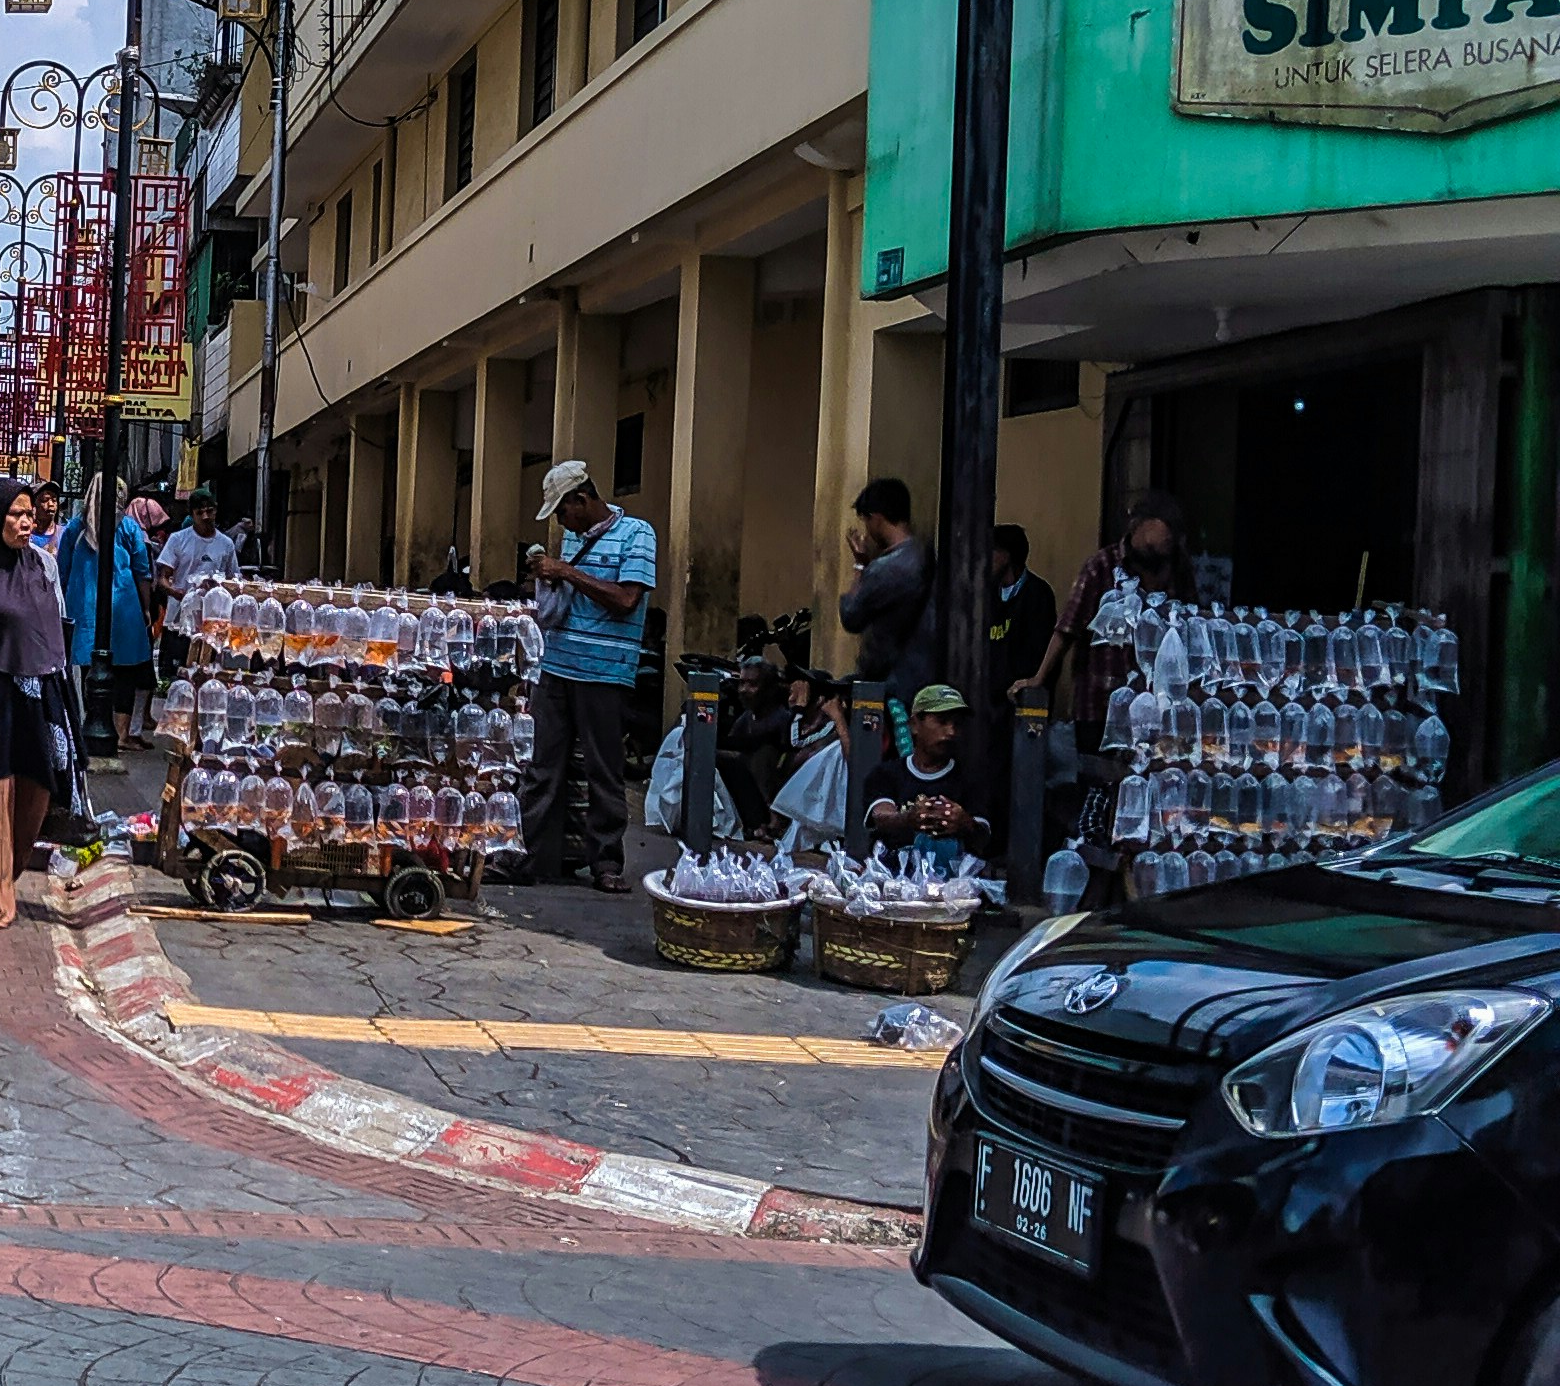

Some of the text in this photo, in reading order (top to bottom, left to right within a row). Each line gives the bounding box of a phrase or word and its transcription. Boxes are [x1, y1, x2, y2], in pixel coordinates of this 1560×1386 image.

[1274, 58, 1354, 89] UNTUK
[1366, 47, 1452, 79] SELERA
[124, 407, 177, 420] ELITA
[980, 1144, 1094, 1235] F 1606 NF
